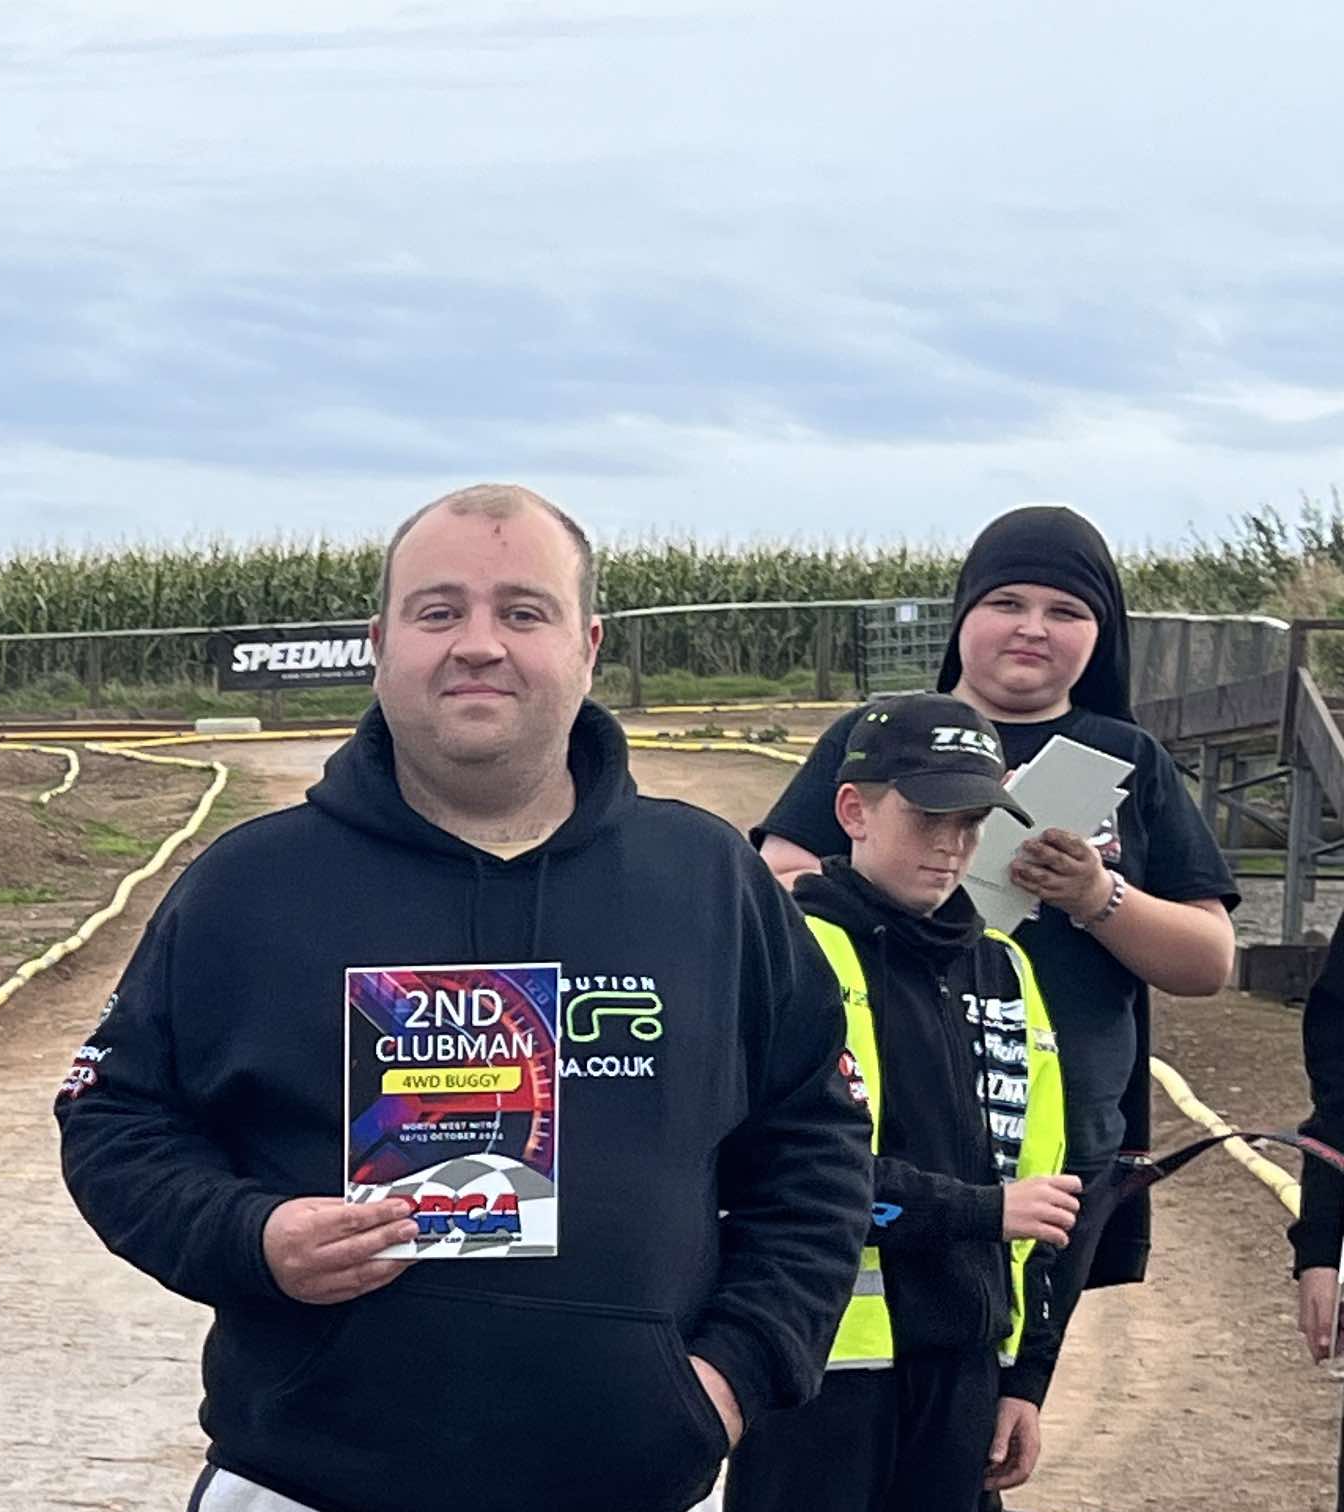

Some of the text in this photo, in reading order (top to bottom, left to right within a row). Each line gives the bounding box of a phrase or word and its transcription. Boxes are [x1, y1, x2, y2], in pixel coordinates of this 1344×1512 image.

[231, 638, 377, 672] SPEEDWU
[560, 975, 655, 992] BUTION
[404, 988, 504, 1029] 2ND
[375, 1033, 534, 1063] CLUBMAN
[402, 1073, 501, 1089] 4WD BUGGY
